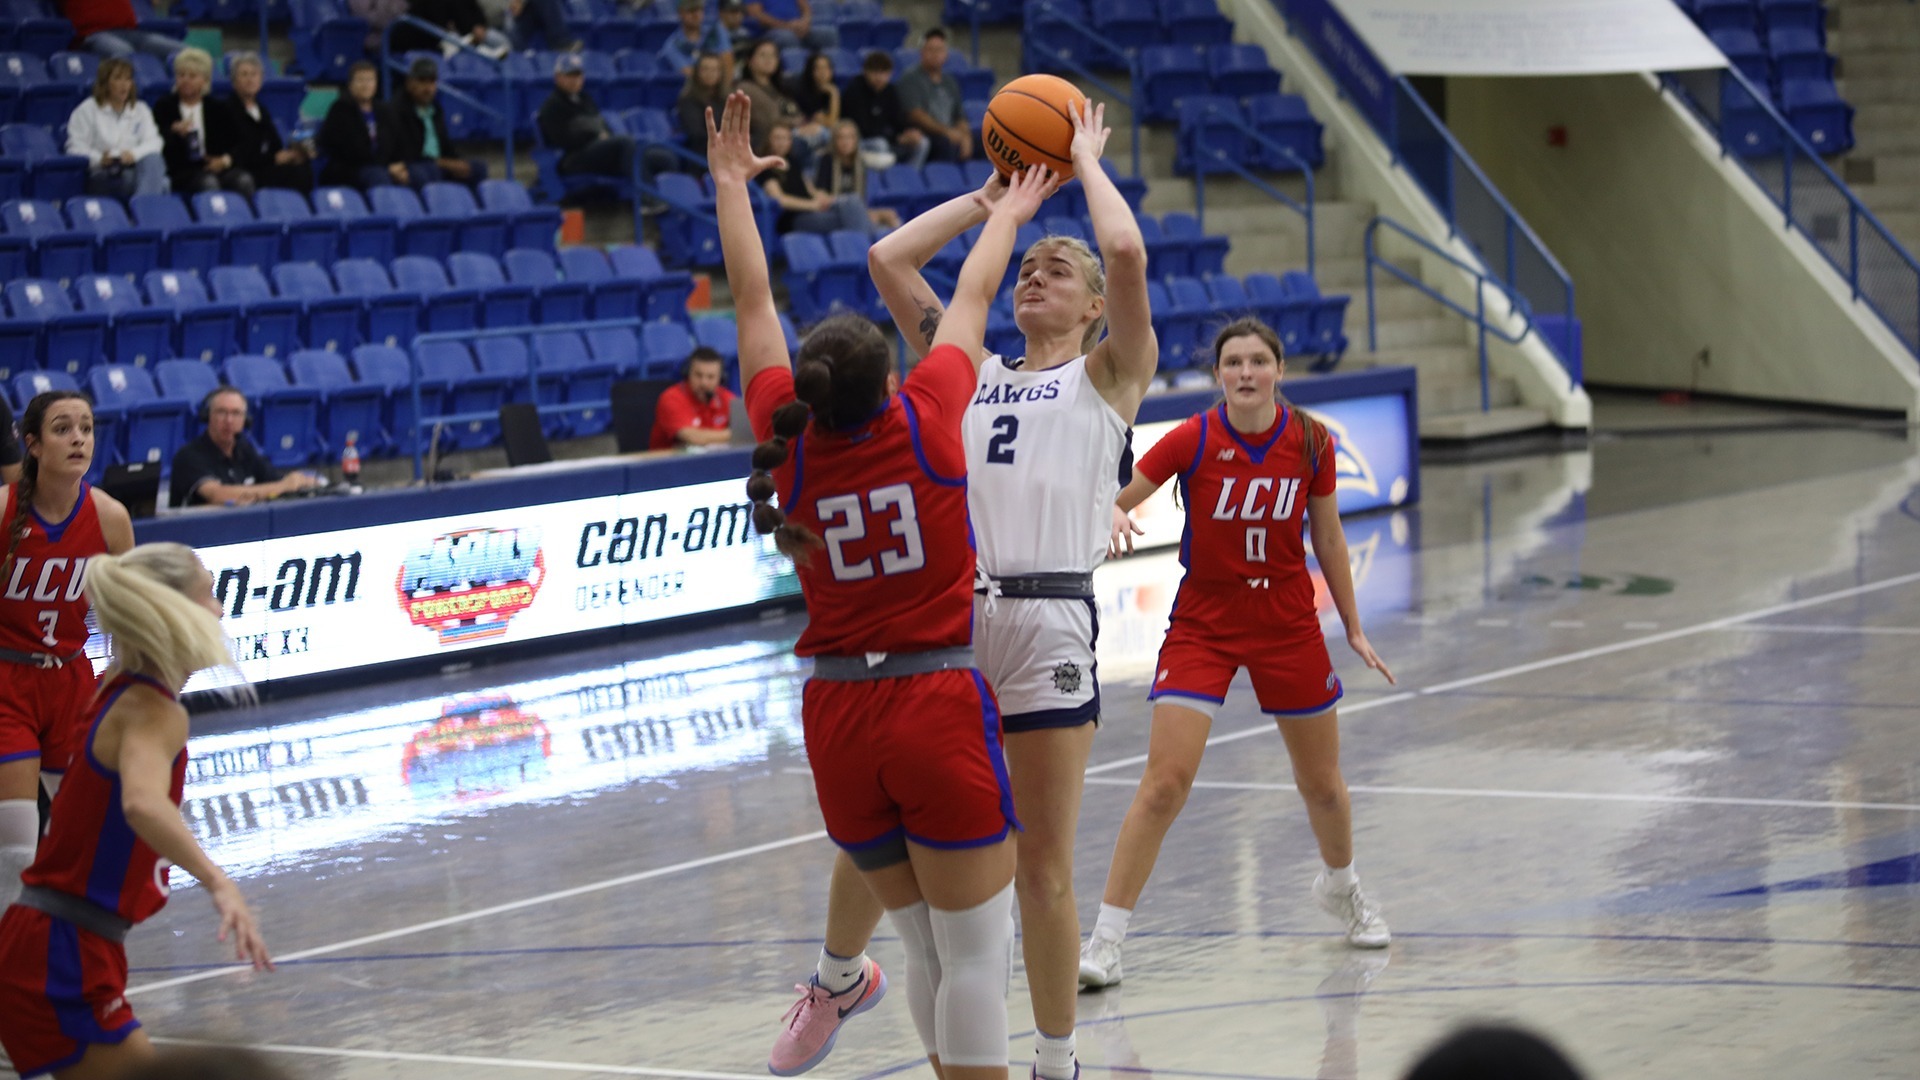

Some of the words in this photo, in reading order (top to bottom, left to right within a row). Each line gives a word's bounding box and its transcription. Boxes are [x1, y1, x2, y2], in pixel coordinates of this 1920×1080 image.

[987, 127, 1053, 179] Wils
[986, 414, 1019, 464] 2
[1211, 476, 1302, 521] LCU
[576, 501, 754, 569] can-am
[816, 482, 926, 582] 23
[1245, 526, 1267, 563] 0
[214, 551, 363, 618] n-am
[576, 570, 685, 611] DEFENDER
